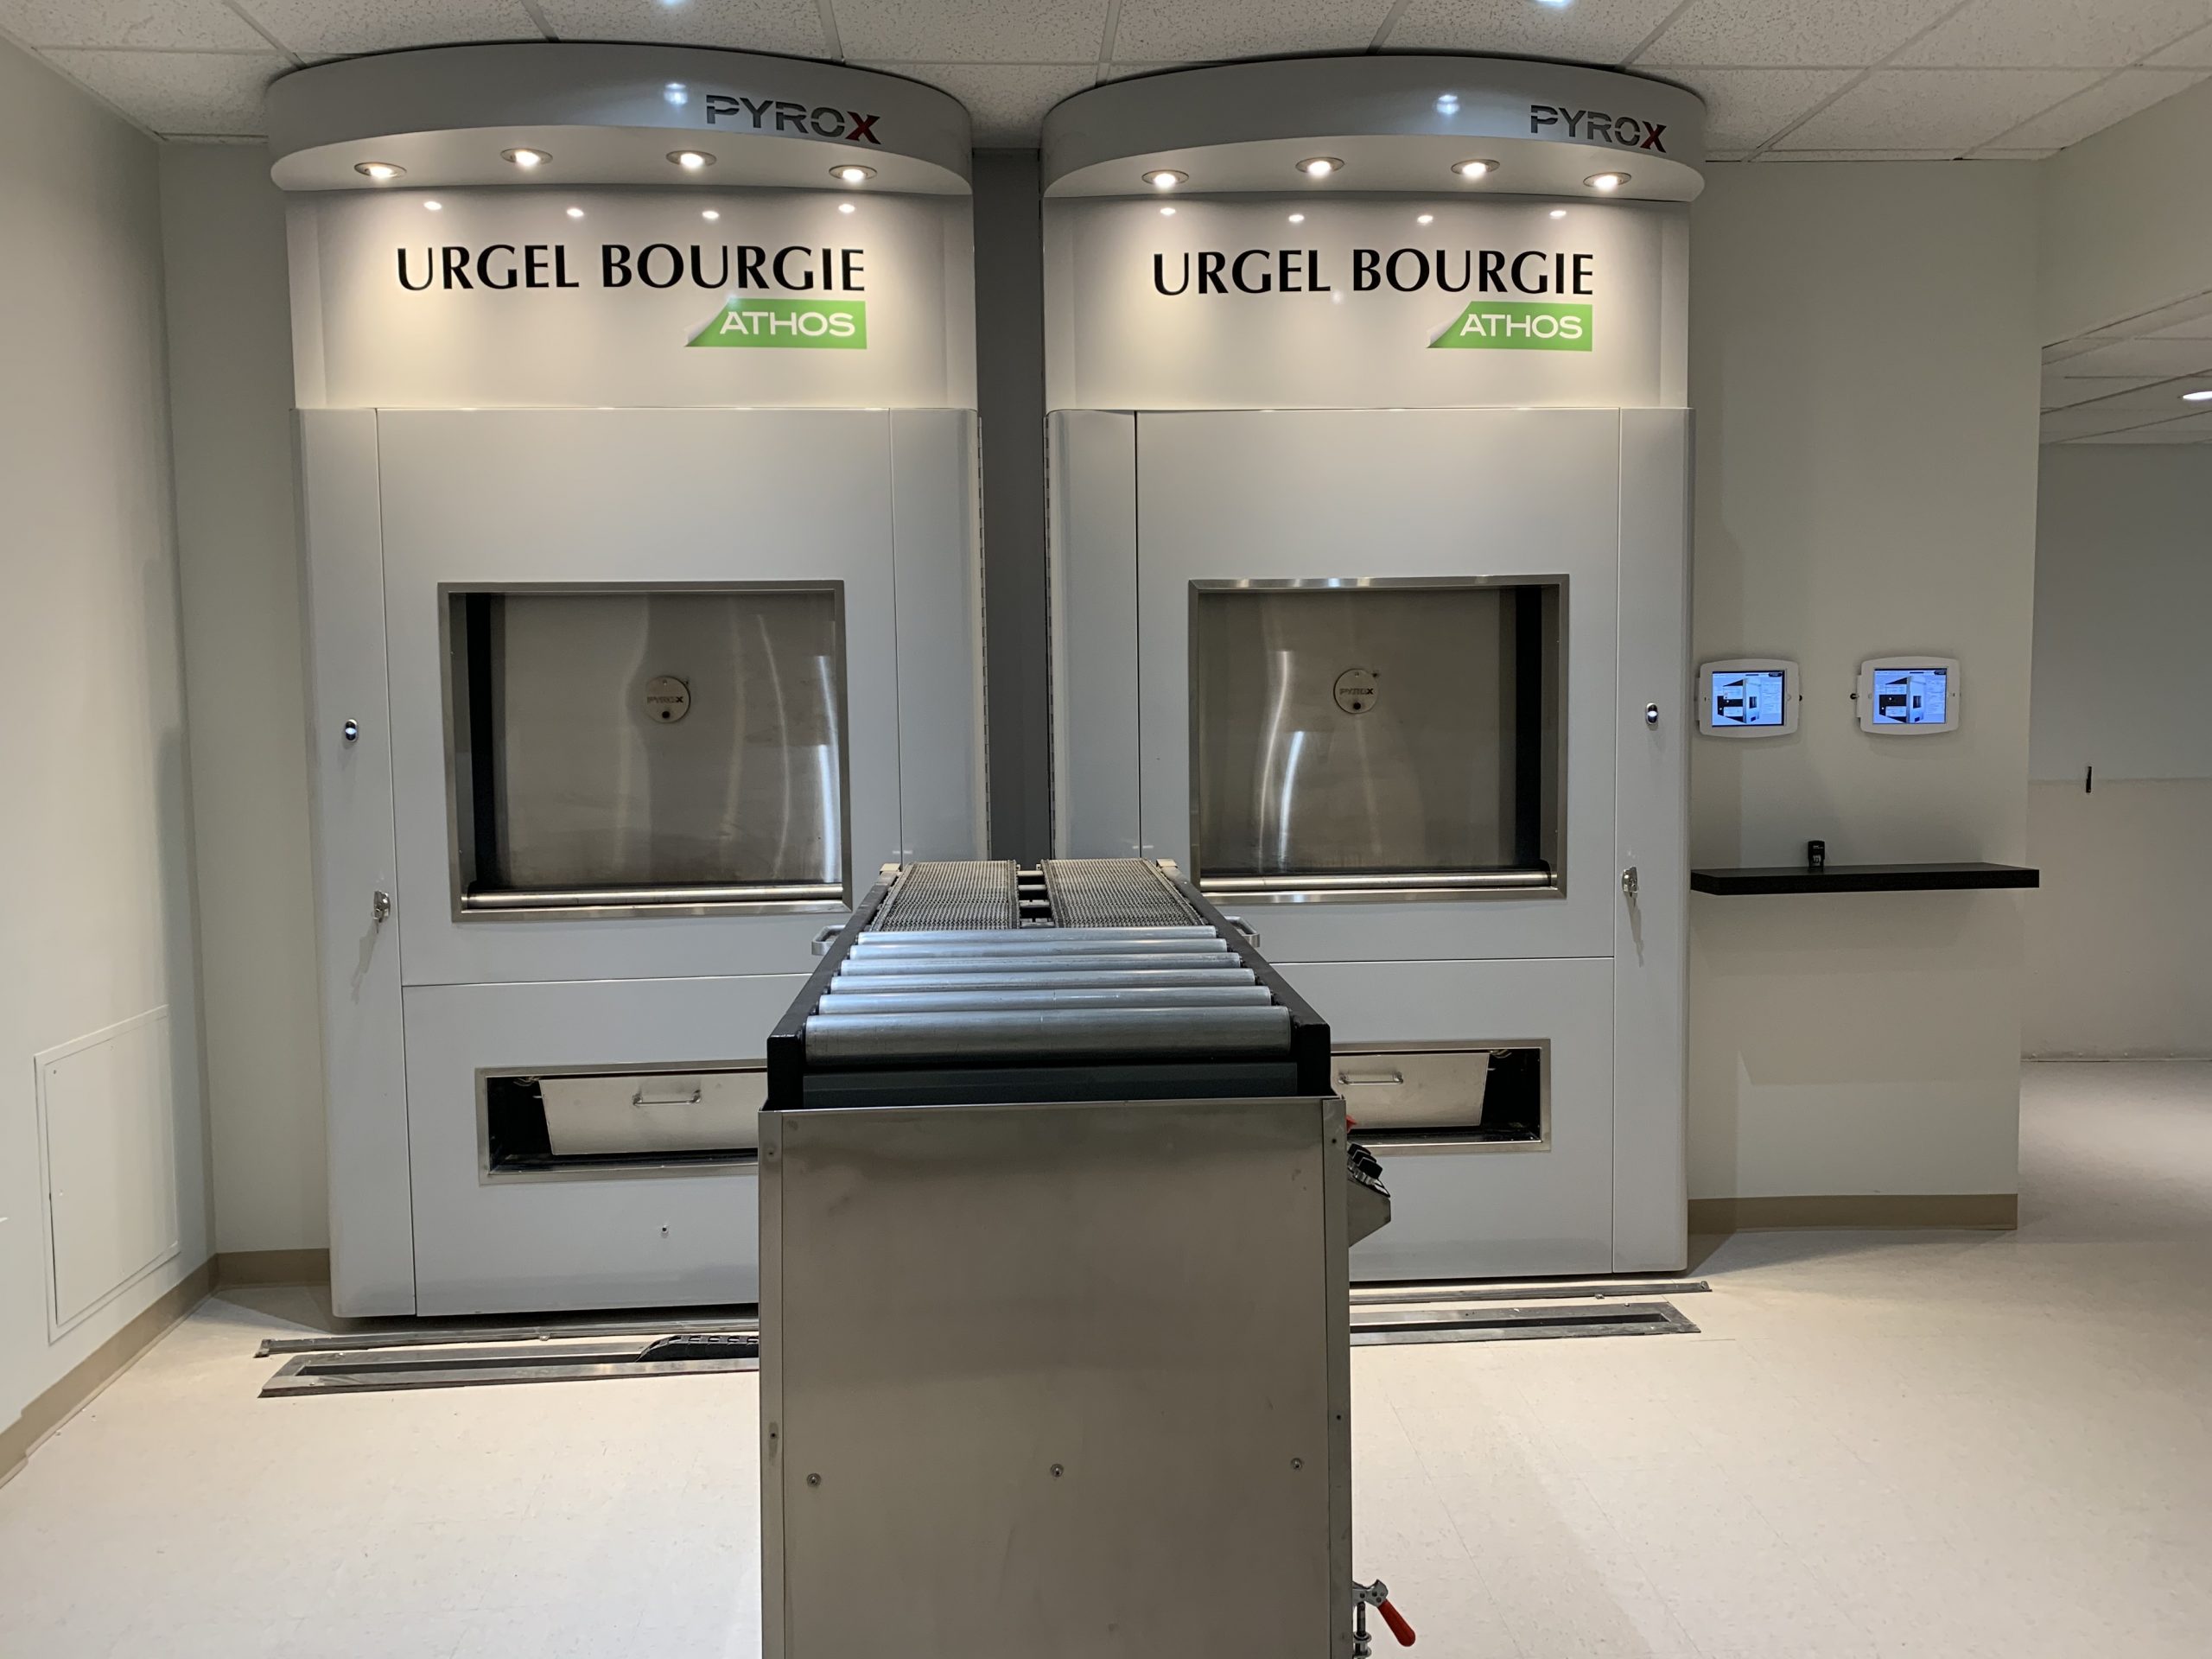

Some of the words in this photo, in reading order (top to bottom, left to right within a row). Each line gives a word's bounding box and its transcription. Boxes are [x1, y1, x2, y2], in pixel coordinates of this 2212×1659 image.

[706, 94, 881, 145] PYROX
[1530, 105, 1667, 154] PYROX
[397, 245, 580, 291] URGEL
[601, 243, 865, 291] BOURGIE
[1154, 250, 1331, 296] URGEL
[1353, 248, 1593, 296] BOURGIE
[719, 310, 855, 338] ATHOS
[1460, 313, 1583, 340] ATHOS
